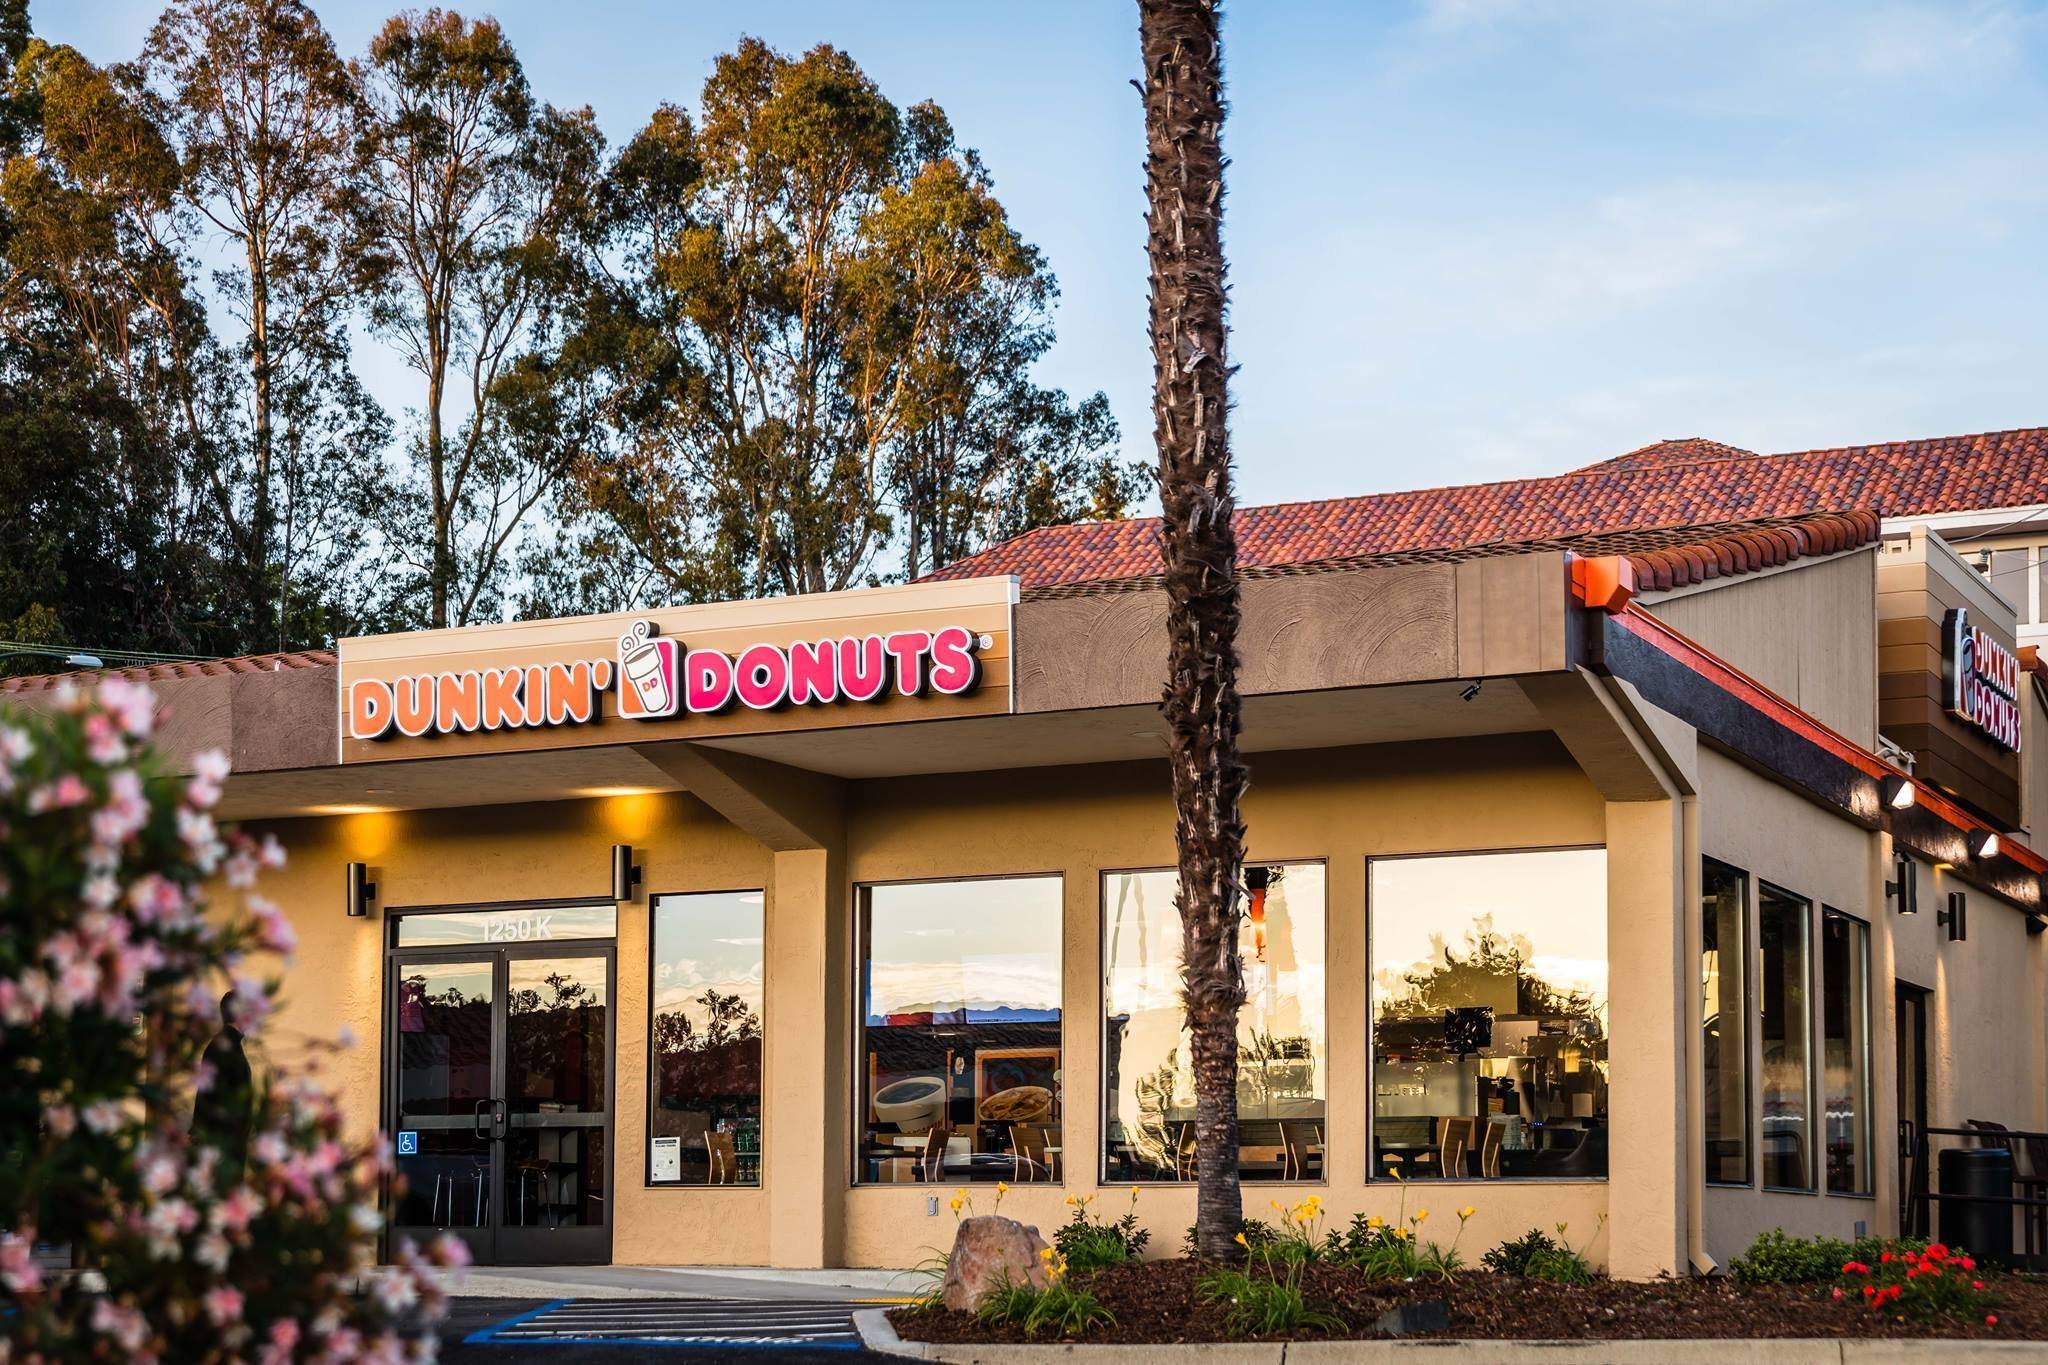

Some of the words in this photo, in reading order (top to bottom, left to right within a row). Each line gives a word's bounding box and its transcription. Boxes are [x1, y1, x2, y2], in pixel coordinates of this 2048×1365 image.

[351, 657, 614, 739] DUNKIN'
[685, 626, 976, 713] DONUTS
[642, 677, 658, 692] DD
[1974, 679, 2021, 753] DONUTS
[482, 917, 531, 942] 1250
[536, 915, 553, 939] K
